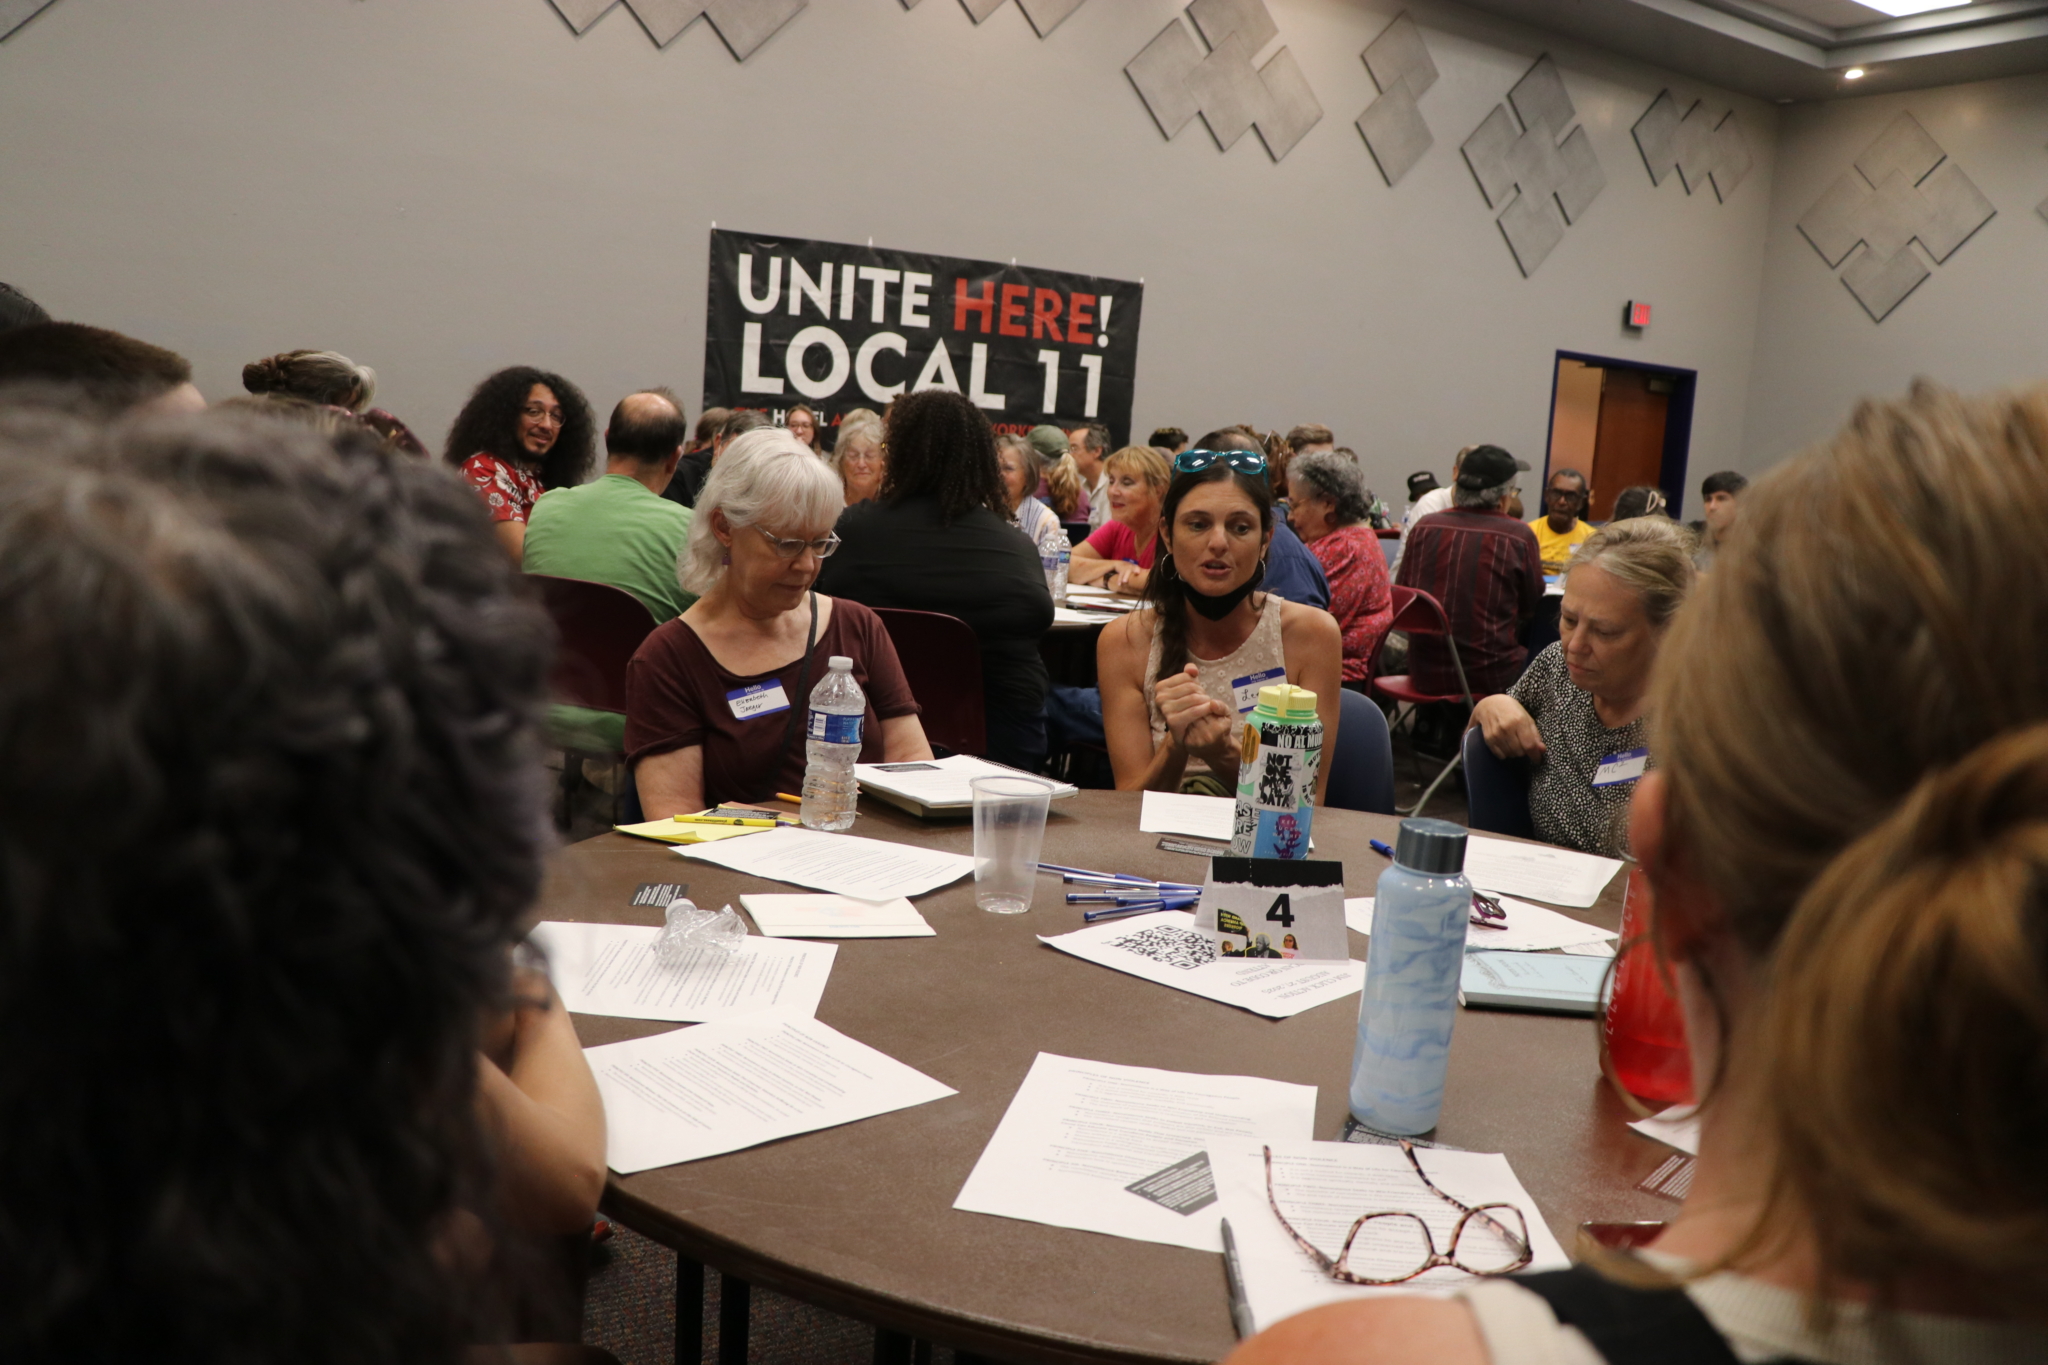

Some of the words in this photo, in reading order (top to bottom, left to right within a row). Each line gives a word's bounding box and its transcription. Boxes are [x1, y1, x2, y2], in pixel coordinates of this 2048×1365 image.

[738, 253, 932, 328] UNITE
[953, 278, 1113, 348] HERE!
[1633, 303, 1651, 325] EXIT
[740, 322, 1005, 411] LOCAL
[1038, 349, 1102, 418] 11
[1250, 672, 1266, 681] Hello
[744, 684, 762, 693] Hello
[1277, 734, 1292, 748] NO
[1294, 735, 1306, 748] AL
[1267, 752, 1293, 767] NOT
[1266, 764, 1292, 778] ONE
[1261, 792, 1290, 807] DATA
[1266, 894, 1294, 927] 4
